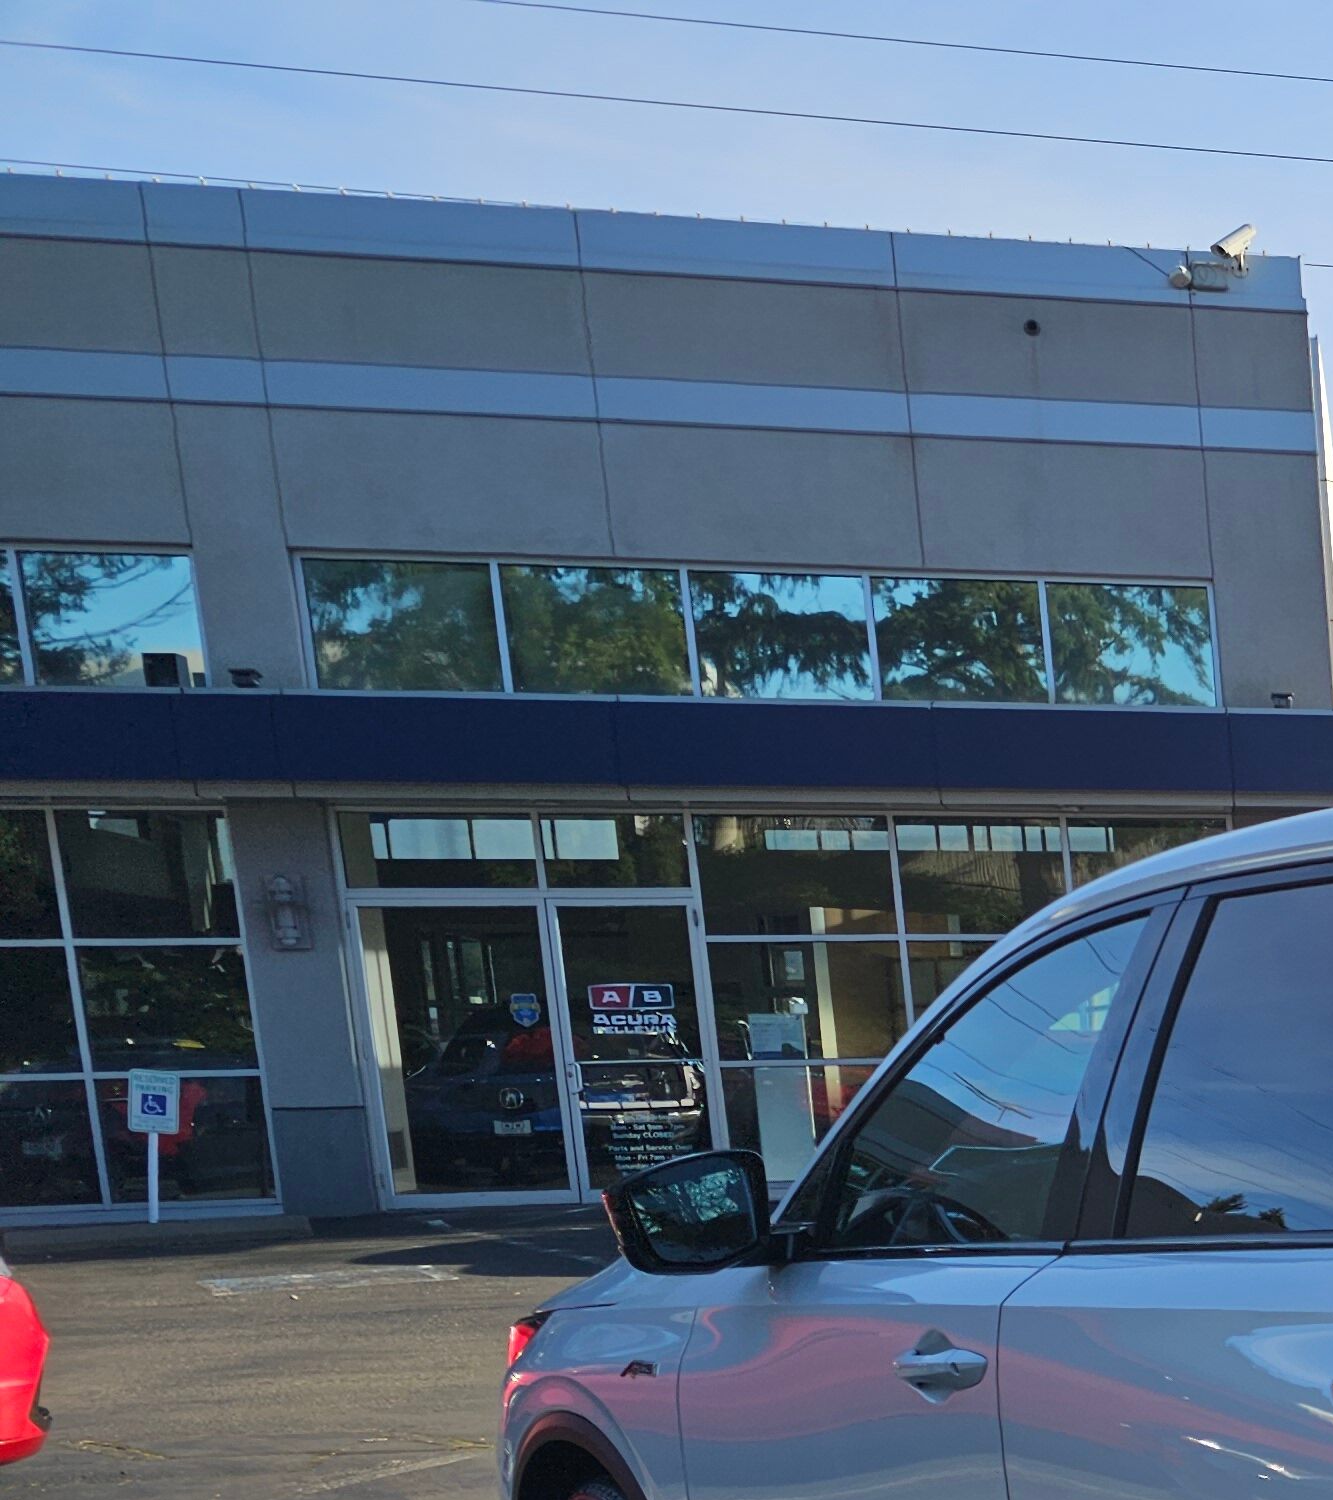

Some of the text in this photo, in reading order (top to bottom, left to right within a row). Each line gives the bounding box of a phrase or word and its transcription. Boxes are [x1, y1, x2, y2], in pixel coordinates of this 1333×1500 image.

[602, 990, 662, 1003] A B
[593, 1014, 677, 1025] ACURA
